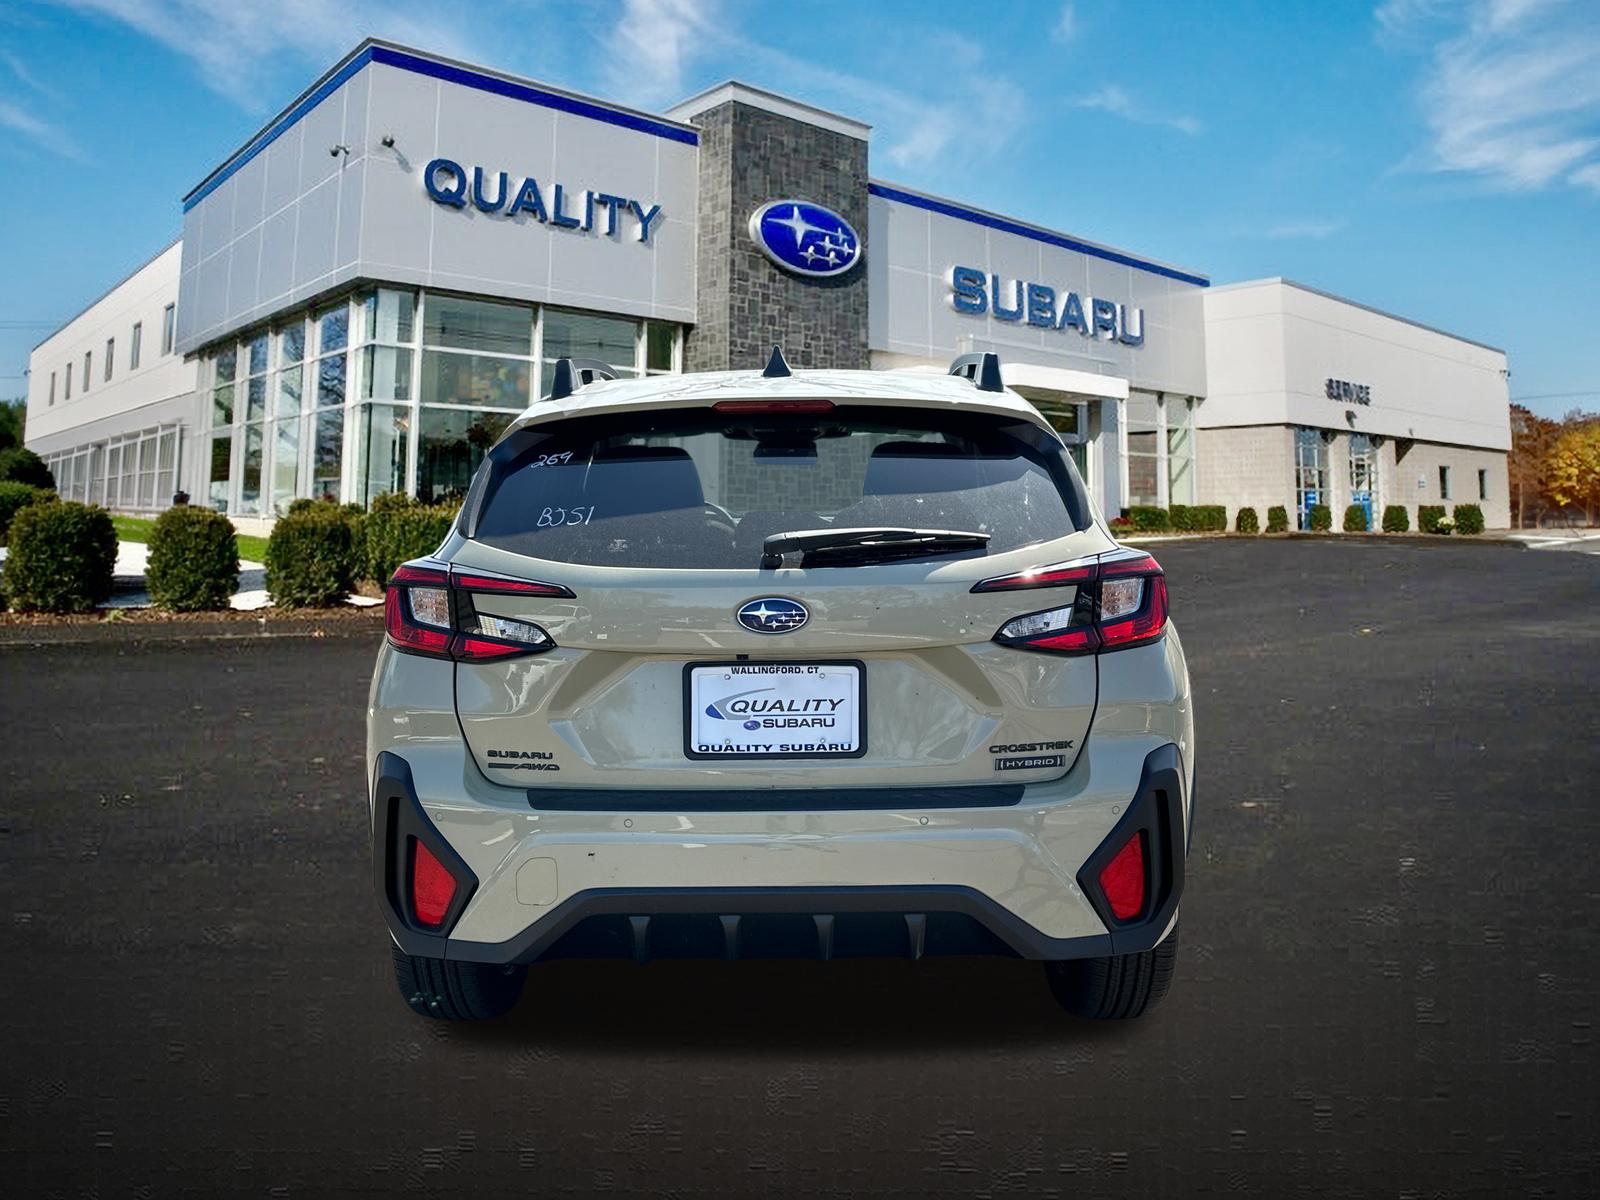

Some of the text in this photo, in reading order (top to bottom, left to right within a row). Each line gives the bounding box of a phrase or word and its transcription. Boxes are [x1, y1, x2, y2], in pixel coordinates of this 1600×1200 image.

[424, 158, 662, 243] QUALITY
[950, 265, 1145, 346] SUBARU
[807, 666, 819, 674] CT
[730, 698, 845, 713] QUALITY
[762, 718, 835, 728] SUBARU
[698, 743, 852, 752] QUALITY SUBARU
[989, 740, 1074, 753] CROSSTREK
[487, 750, 553, 759] SUBARU
[1006, 758, 1054, 766] HYBRID
[514, 763, 560, 771] AWD
